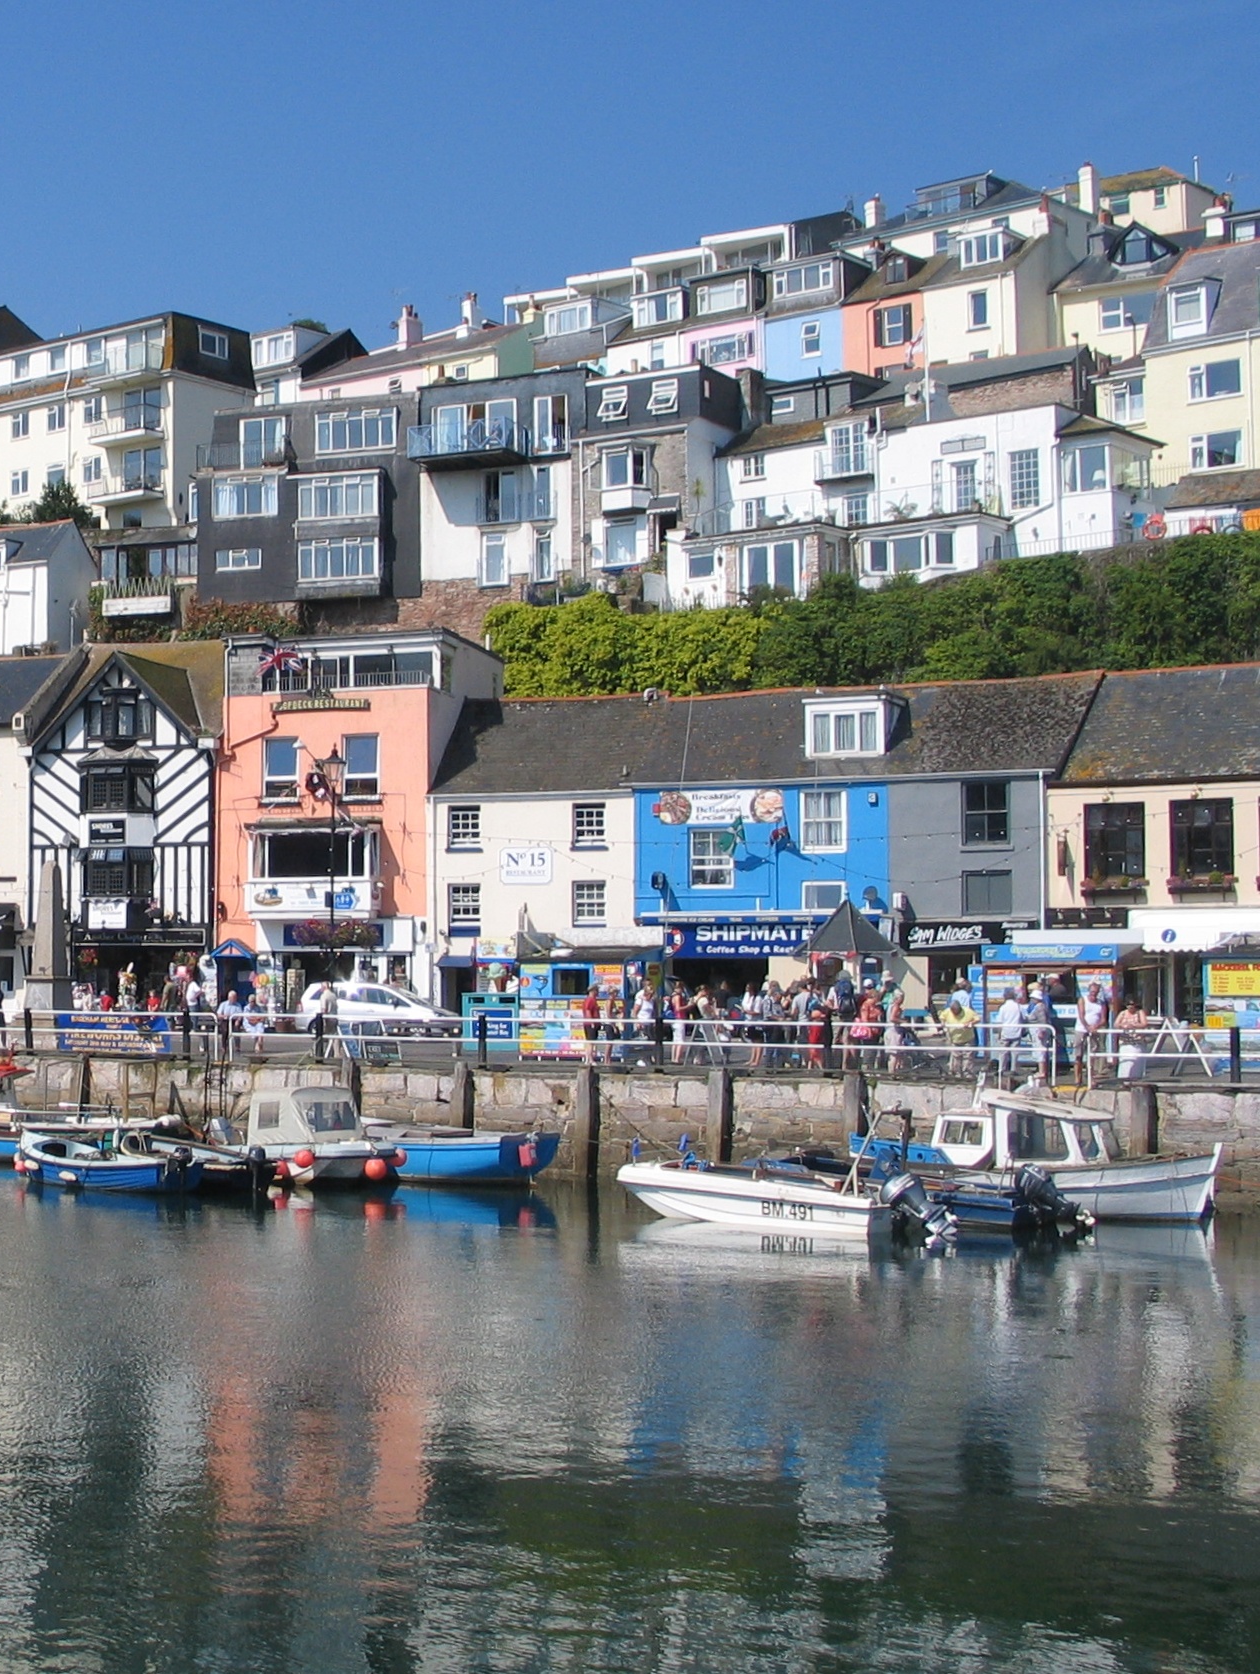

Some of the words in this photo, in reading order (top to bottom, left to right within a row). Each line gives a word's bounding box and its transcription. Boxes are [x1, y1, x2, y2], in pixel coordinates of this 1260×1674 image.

[530, 852, 546, 867] 15
[936, 925, 983, 941] WIDGES
[706, 944, 736, 954] Coffee
[738, 944, 760, 955] Shop
[761, 1200, 813, 1221] BM.491
